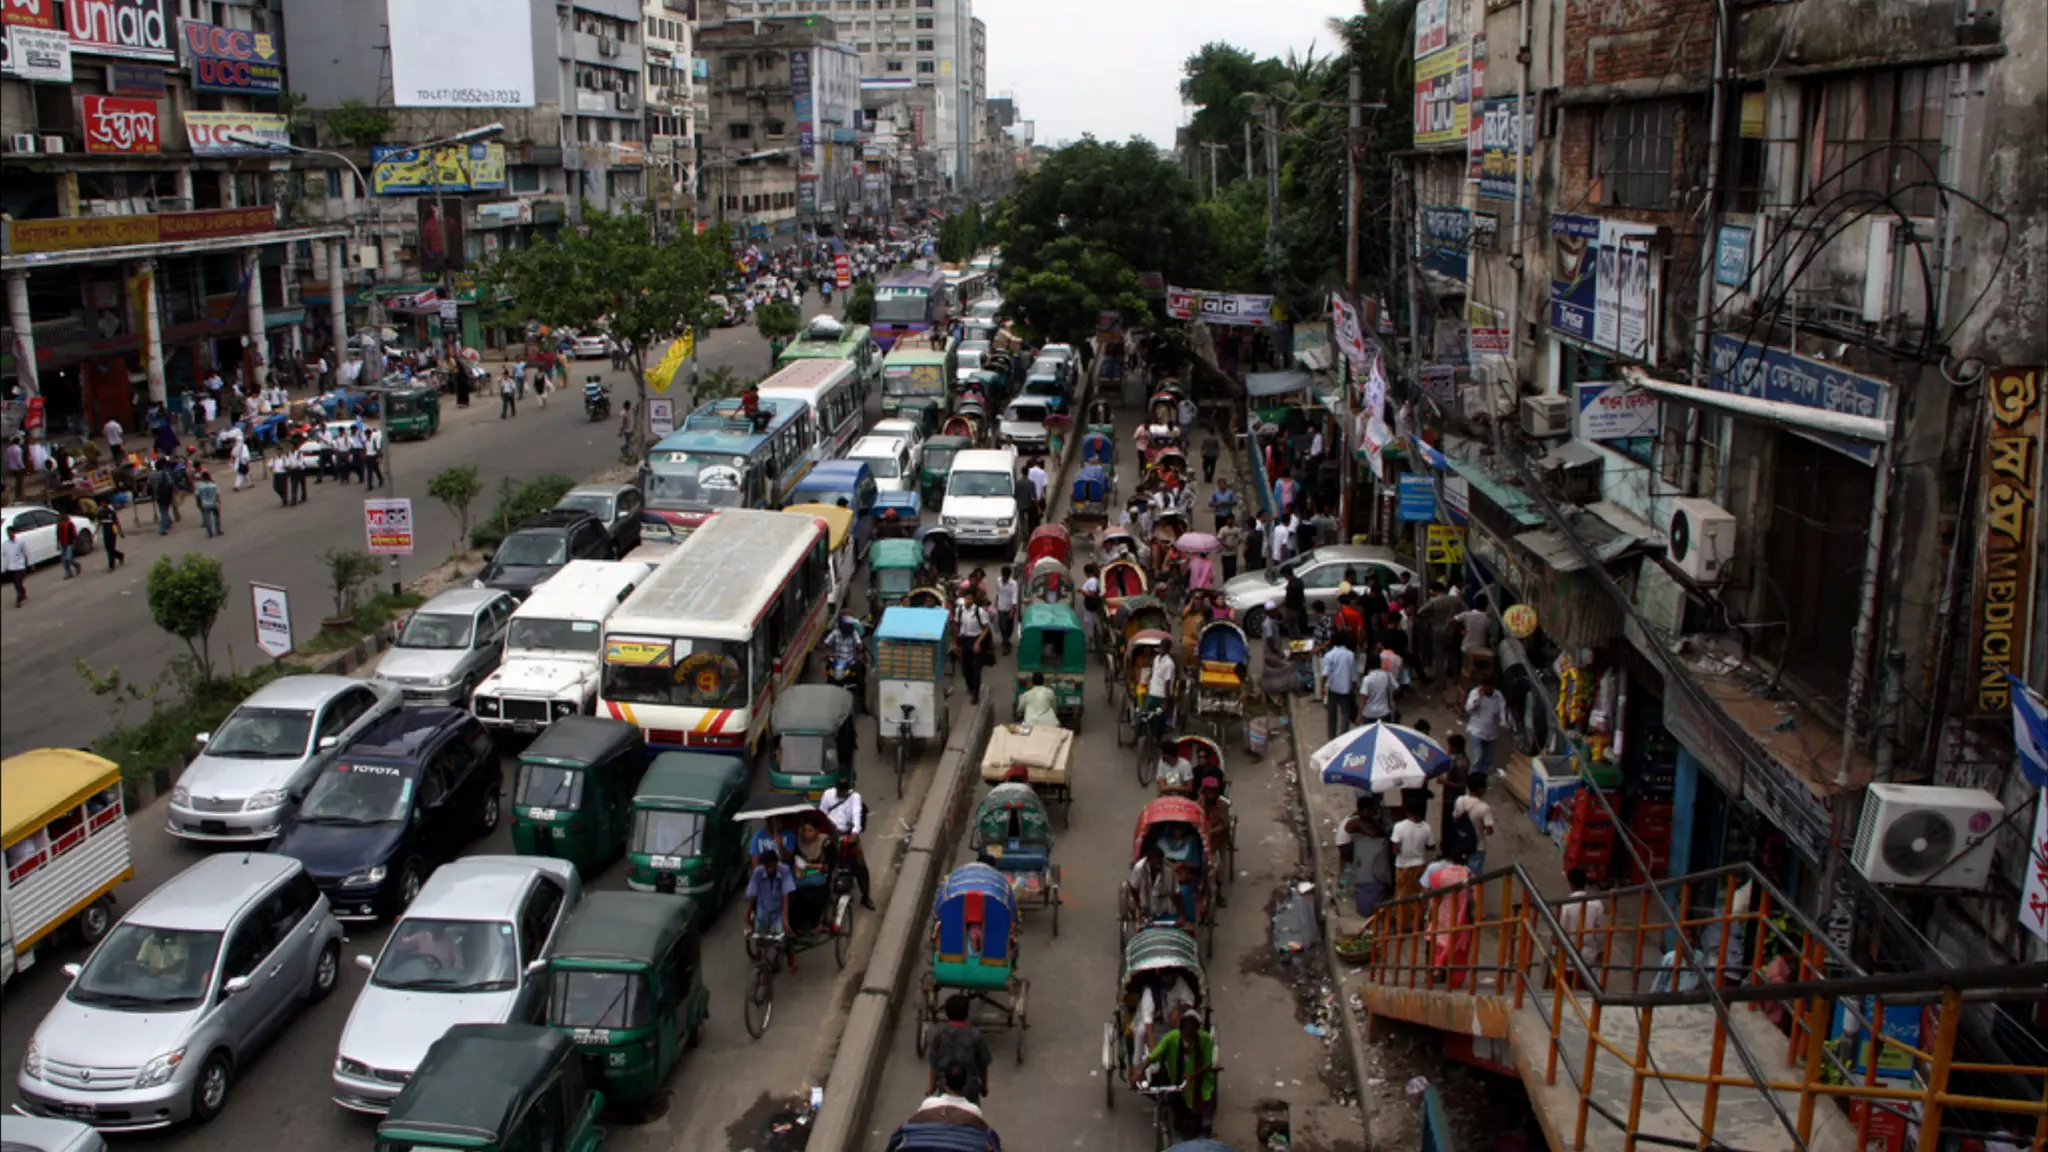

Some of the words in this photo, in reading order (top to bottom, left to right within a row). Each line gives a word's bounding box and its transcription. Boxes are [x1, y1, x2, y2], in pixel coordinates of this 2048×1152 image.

[184, 23, 251, 59] UCC
[200, 57, 250, 86] UCC
[1980, 553, 2016, 714] MEDICINE
[352, 765, 400, 777] TOYOTA
